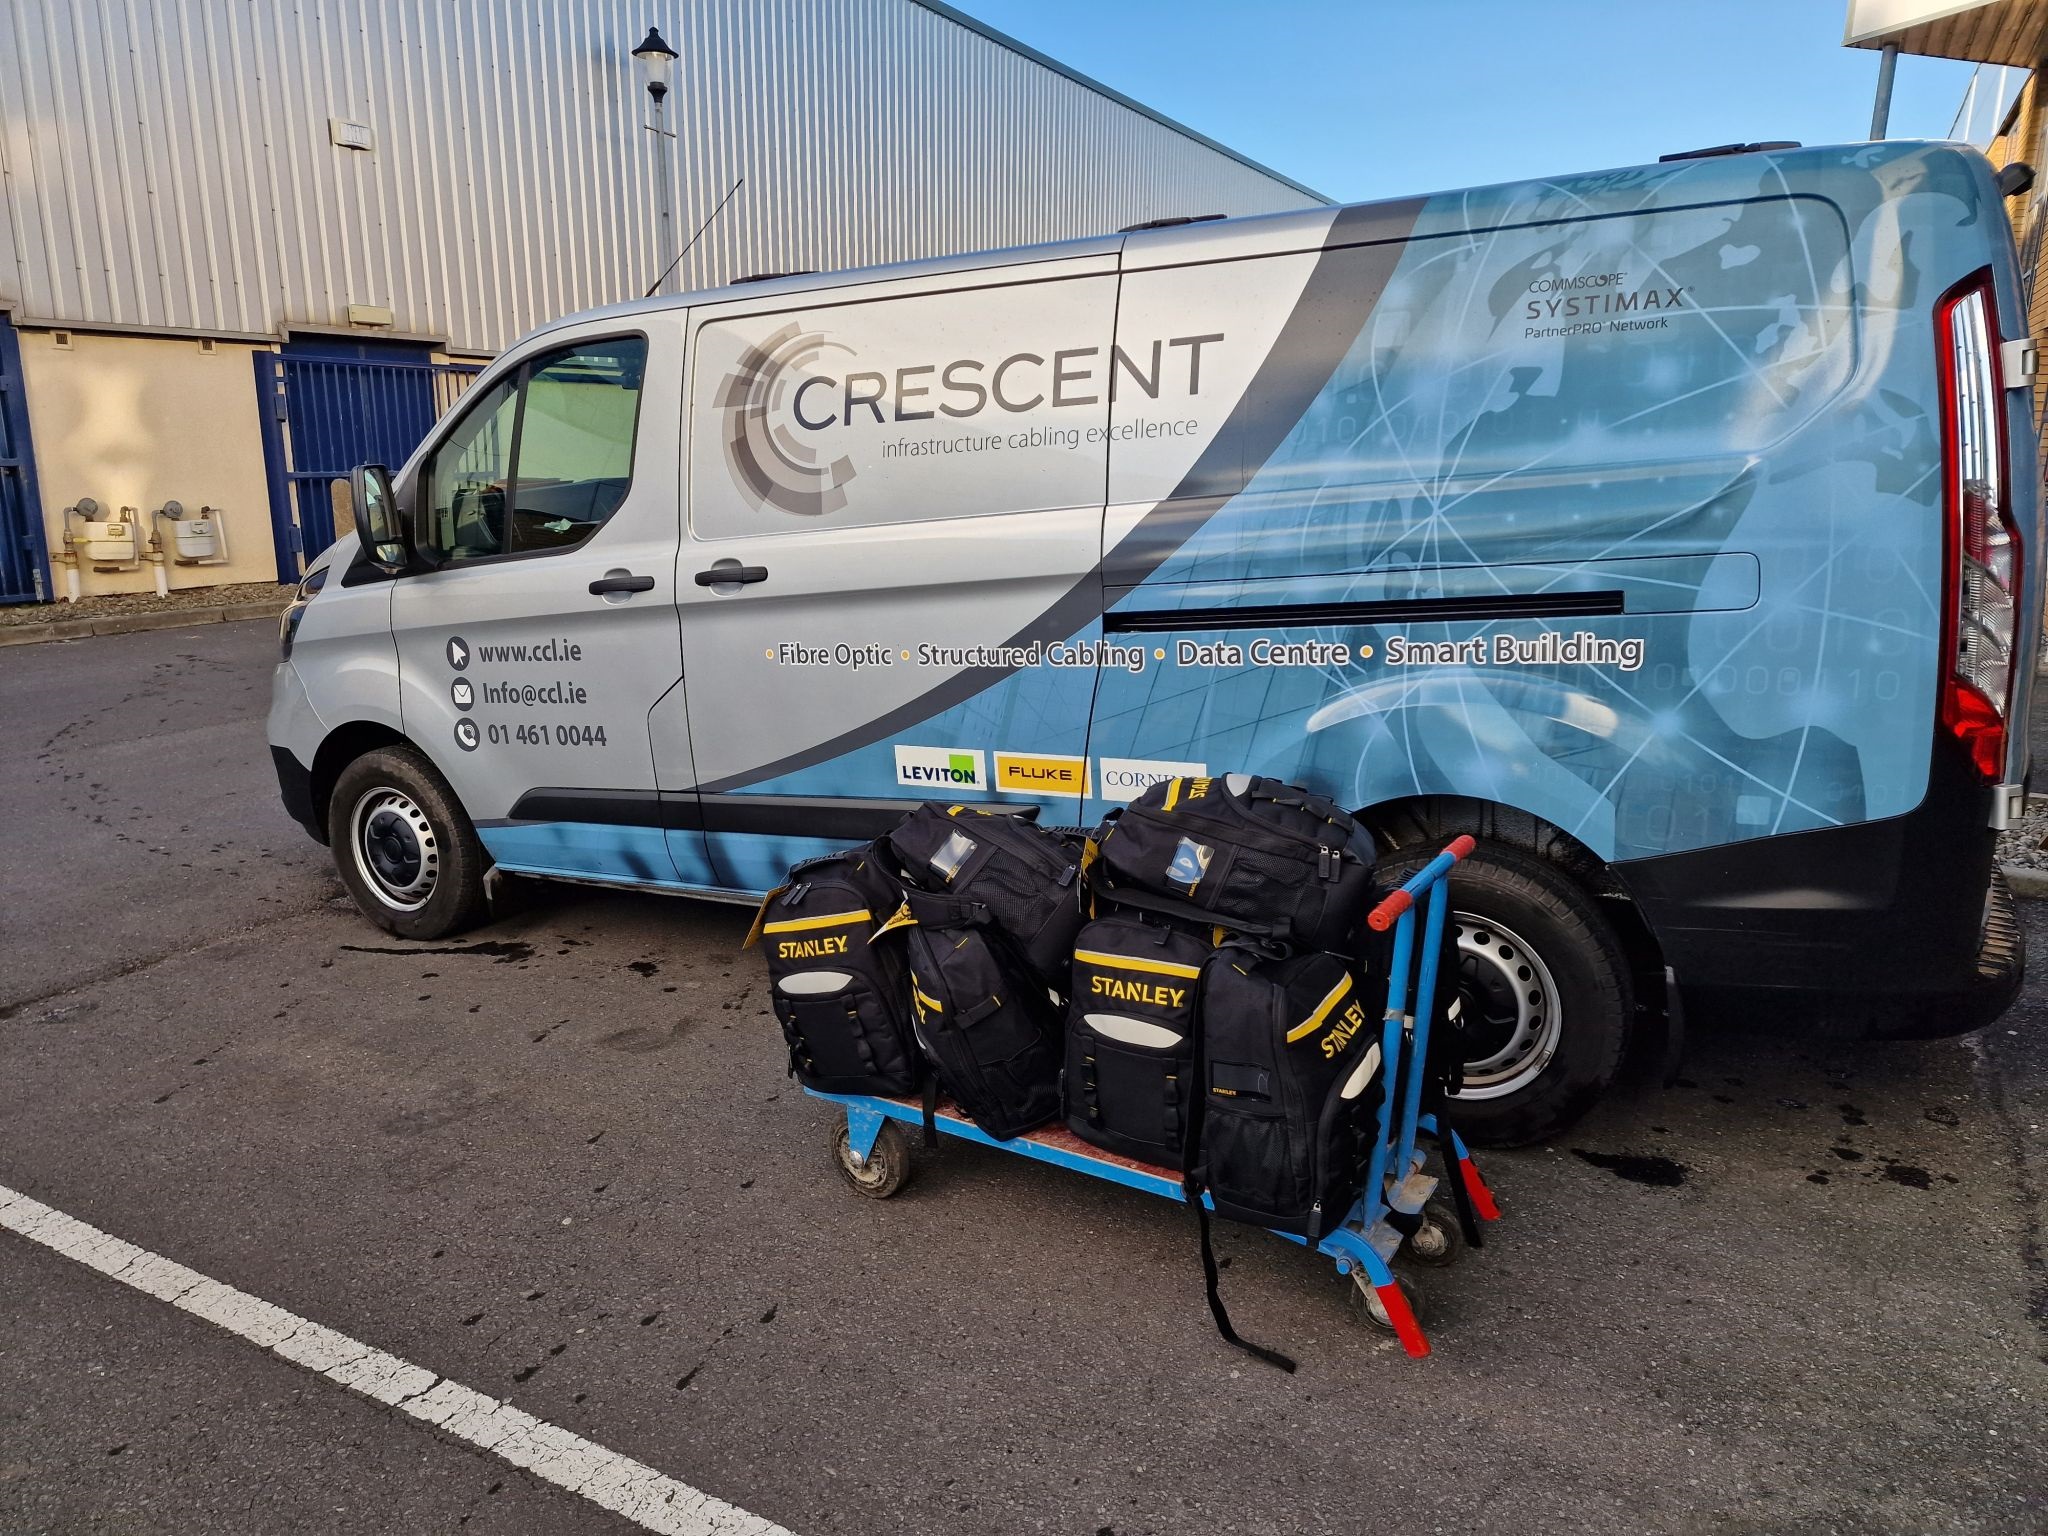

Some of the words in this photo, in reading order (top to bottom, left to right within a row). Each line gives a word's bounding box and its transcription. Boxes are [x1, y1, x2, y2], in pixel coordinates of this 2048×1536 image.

[1528, 272, 1624, 294] COMMSCOPE
[1526, 287, 1684, 320] SYSTIMAX
[1609, 316, 1668, 332] Network
[793, 333, 1225, 431] CRESCENT
[881, 433, 1002, 458] infrastructure
[1007, 424, 1079, 451] cabling
[1085, 416, 1199, 443] excellence
[479, 638, 582, 662] www.ccl.ie
[778, 642, 829, 666] Fibre
[834, 643, 893, 671] Optic
[917, 642, 1042, 667] Structured
[1046, 640, 1145, 673] Cabling
[1177, 639, 1244, 667] Data
[1249, 638, 1350, 667] Centre
[1385, 635, 1485, 665] Smart
[1493, 631, 1645, 671] Building
[483, 681, 587, 707] Info@ccl.ie
[488, 724, 510, 745] 01
[516, 725, 550, 746] 461
[556, 725, 607, 747] 0044
[902, 765, 976, 784] LEVITON
[1008, 766, 1073, 781] FLUKE
[1106, 771, 1183, 788] CORN
[778, 935, 848, 958] STANLEY
[1091, 975, 1186, 1007] STANLEY
[1320, 999, 1366, 1059] STANLEY
